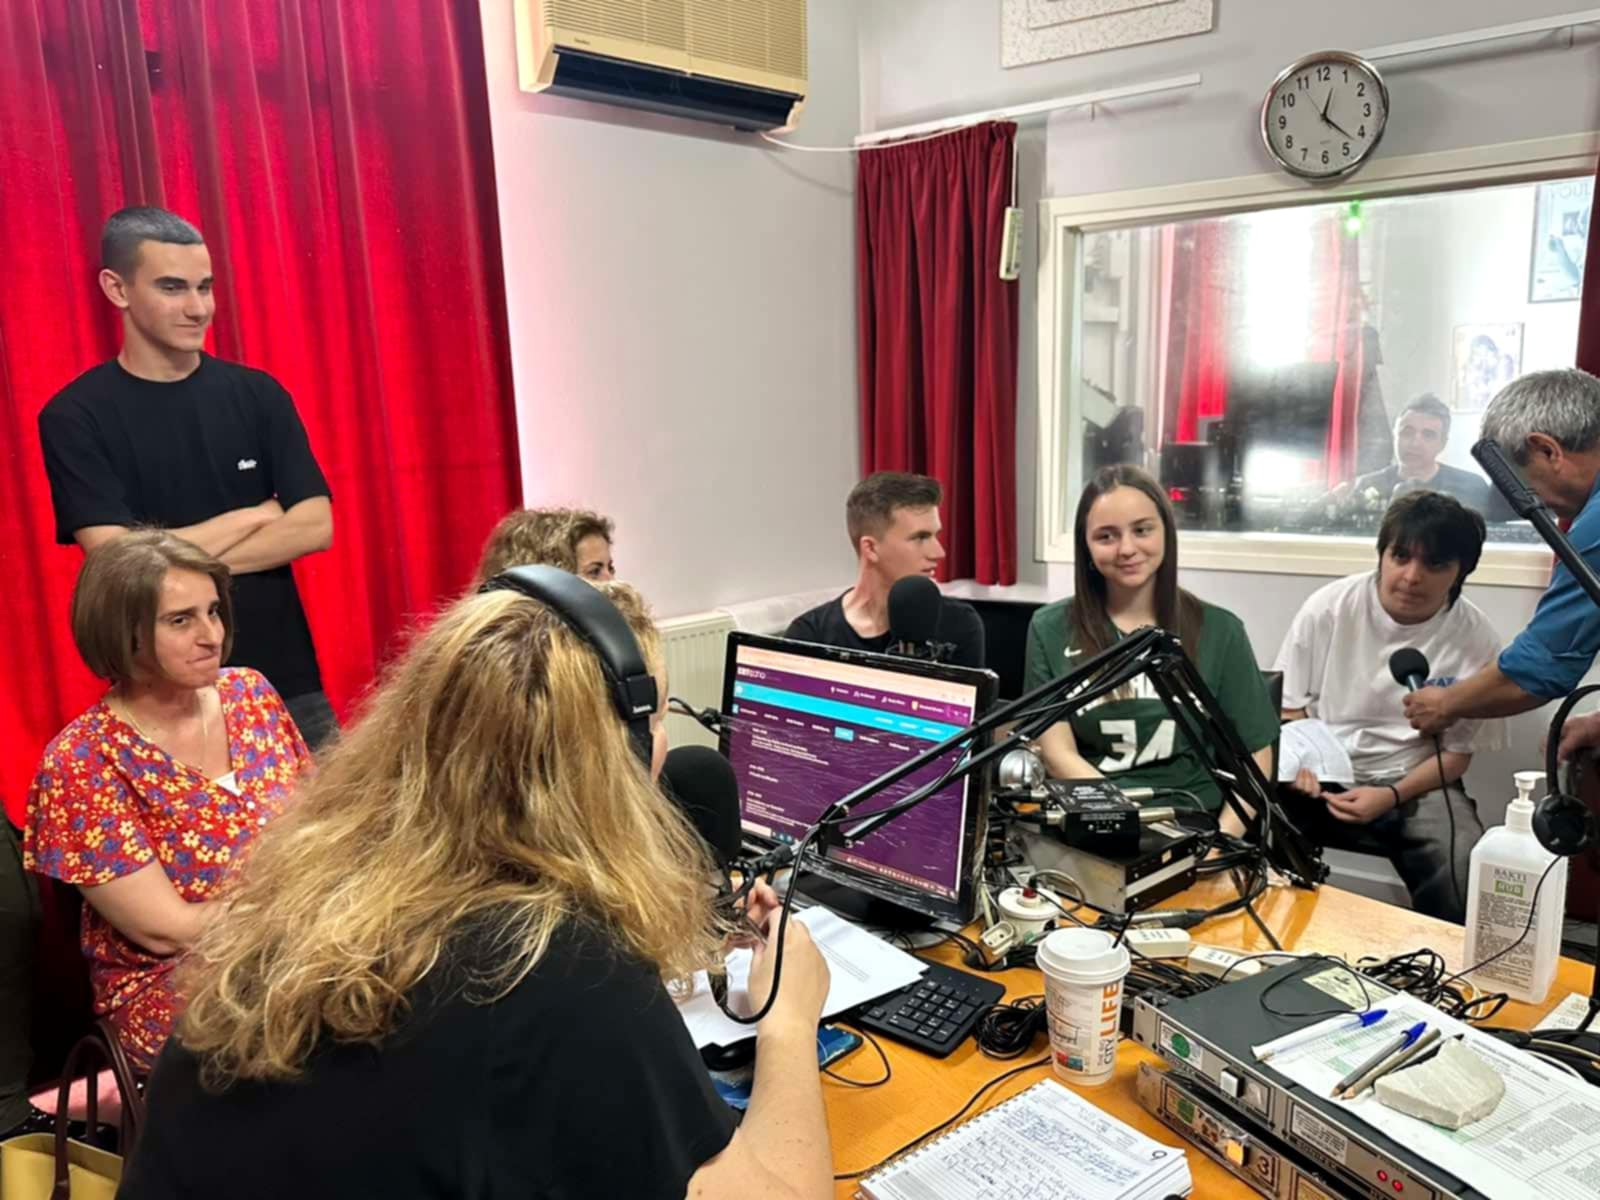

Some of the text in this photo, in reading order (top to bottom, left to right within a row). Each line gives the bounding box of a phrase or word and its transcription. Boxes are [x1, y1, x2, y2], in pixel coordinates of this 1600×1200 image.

[1317, 66, 1331, 82] 12
[1342, 70, 1348, 83] 1
[1296, 76, 1309, 90] 11
[1357, 82, 1365, 97] 2
[1281, 93, 1295, 108] 10
[1363, 103, 1371, 117] 3
[1279, 115, 1286, 130] 9
[1358, 125, 1365, 138] 4
[1285, 135, 1293, 149] 8
[1342, 142, 1350, 156] 5
[1301, 148, 1308, 161] 7
[1321, 151, 1329, 164] 6
[1100, 982, 1120, 1037] LIFE
[1103, 1039, 1114, 1065] CITY
